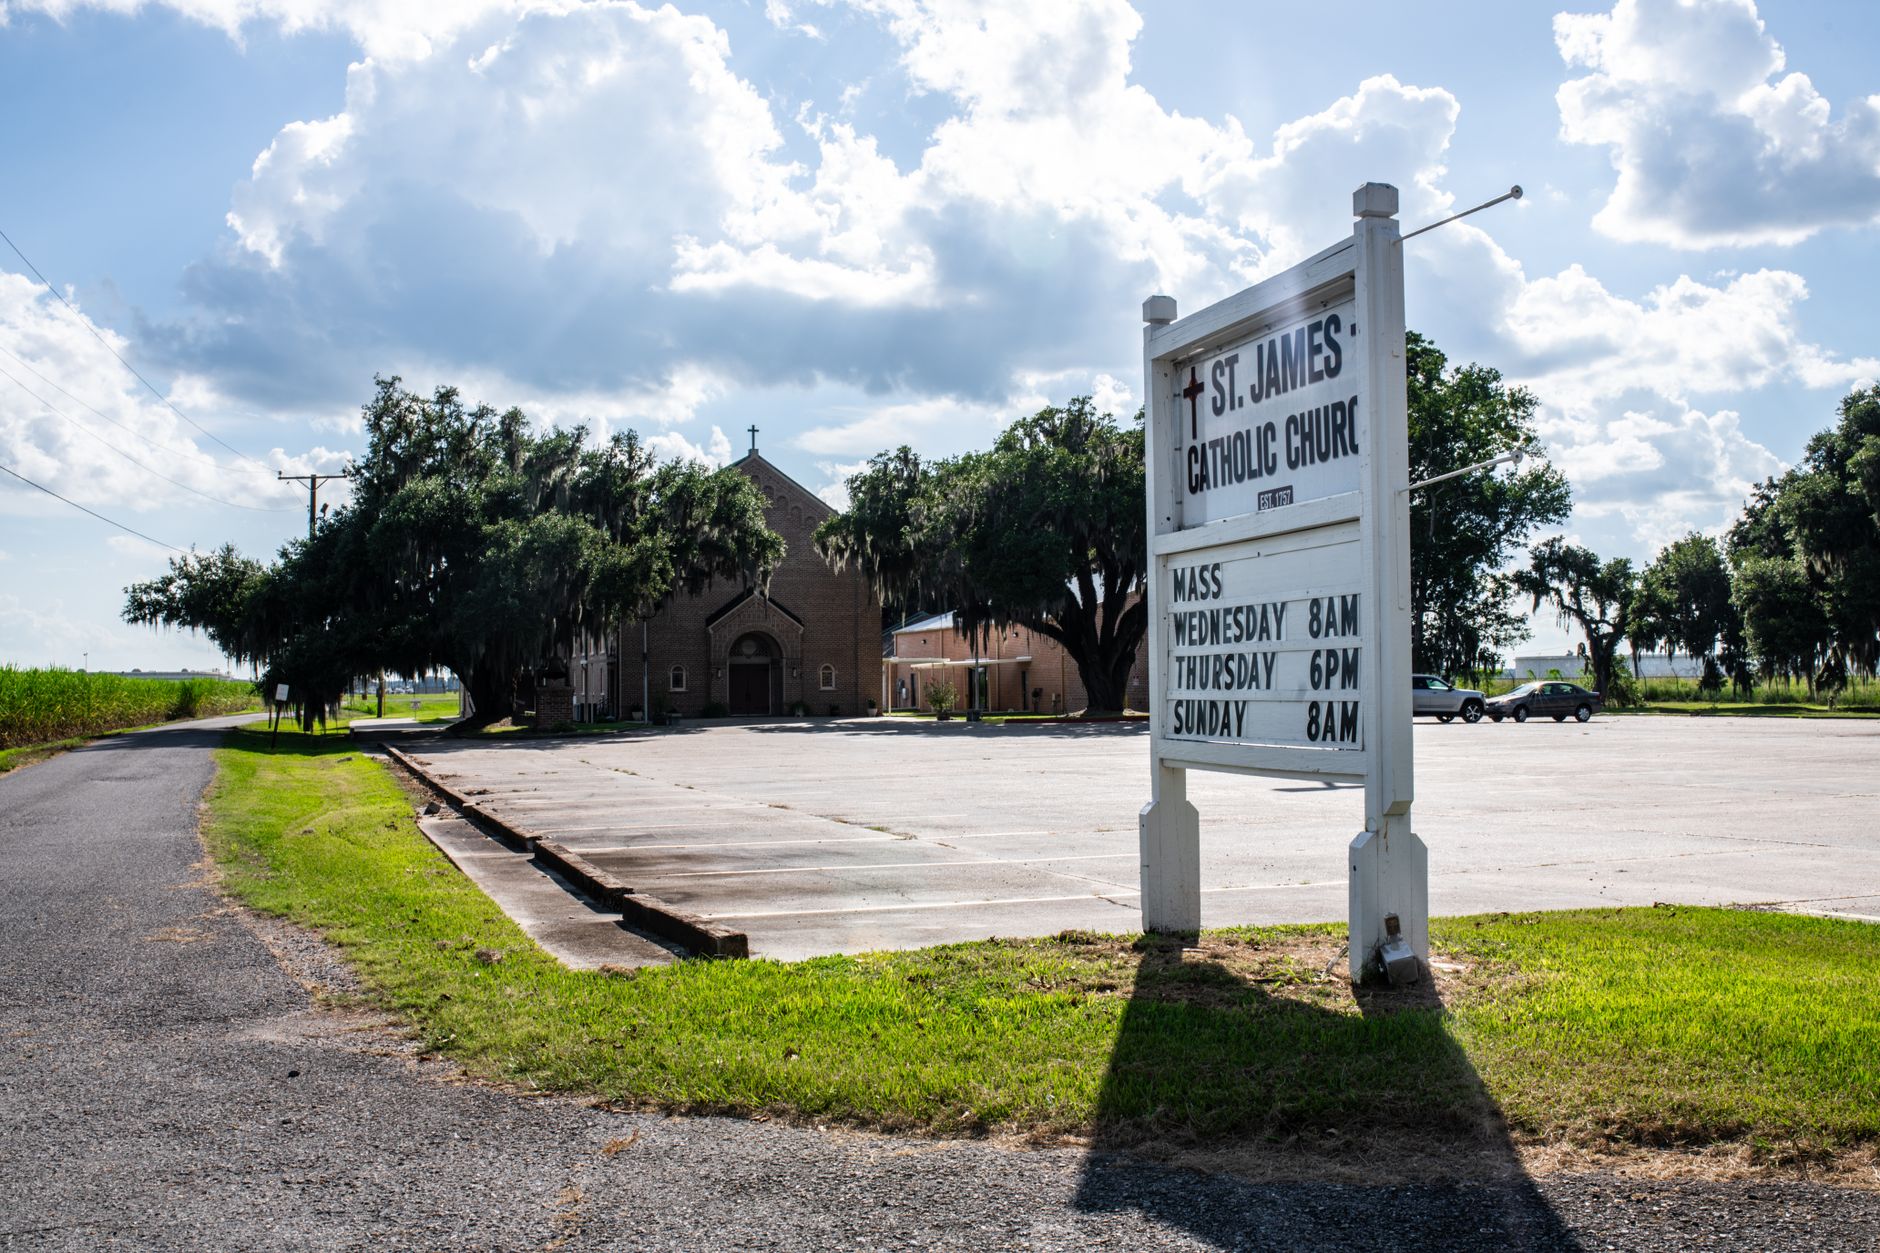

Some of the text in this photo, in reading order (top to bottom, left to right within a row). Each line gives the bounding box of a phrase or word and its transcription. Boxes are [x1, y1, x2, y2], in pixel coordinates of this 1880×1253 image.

[1211, 313, 1342, 417] ST. JAMES
[1187, 395, 1358, 495] CATHOLIC CHURC
[1260, 490, 1291, 510] EST. 1757
[1173, 562, 1221, 603] MASS
[1173, 594, 1358, 646] WEDNESDAY 8AM
[1175, 648, 1358, 690] THURSDAY 6PM
[1173, 700, 1357, 743] SUNDAY 8AM
